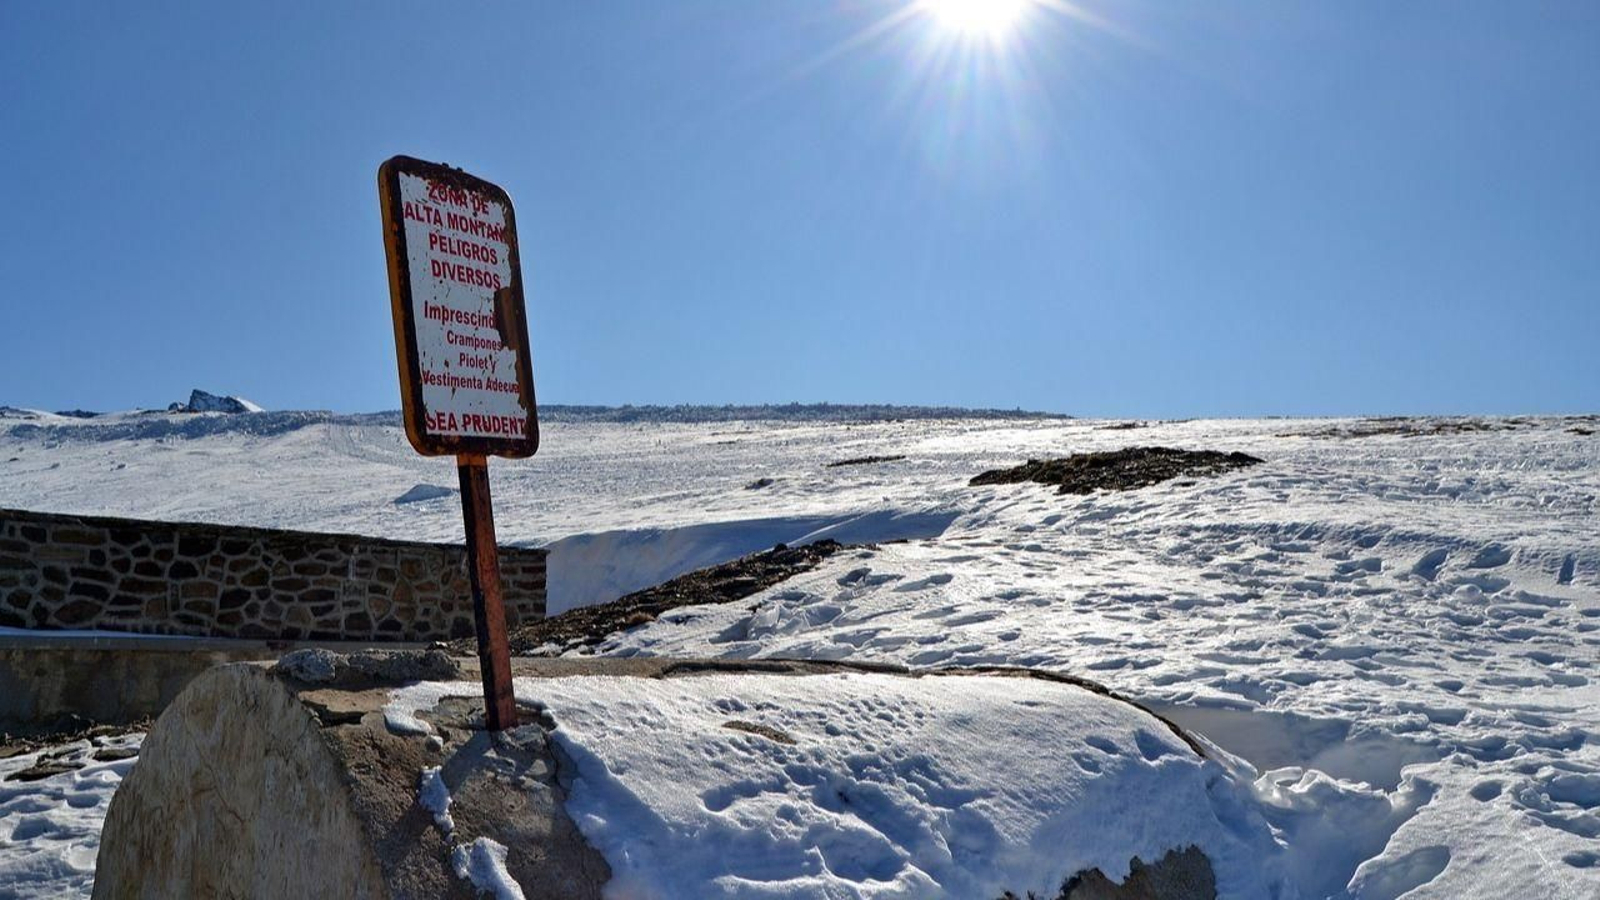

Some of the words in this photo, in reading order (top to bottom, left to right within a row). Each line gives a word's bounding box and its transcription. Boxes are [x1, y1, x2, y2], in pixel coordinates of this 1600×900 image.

[428, 182, 468, 209] ZONA
[471, 192, 490, 215] DE
[404, 201, 443, 227] ALTA
[429, 232, 498, 265] PELIGROS
[431, 259, 501, 291] DIVERSOS
[446, 330, 503, 352] Crampones
[460, 352, 488, 370] Piolet
[490, 359, 497, 374] y
[421, 369, 483, 390] Vestimenta
[425, 411, 458, 431] SEA
